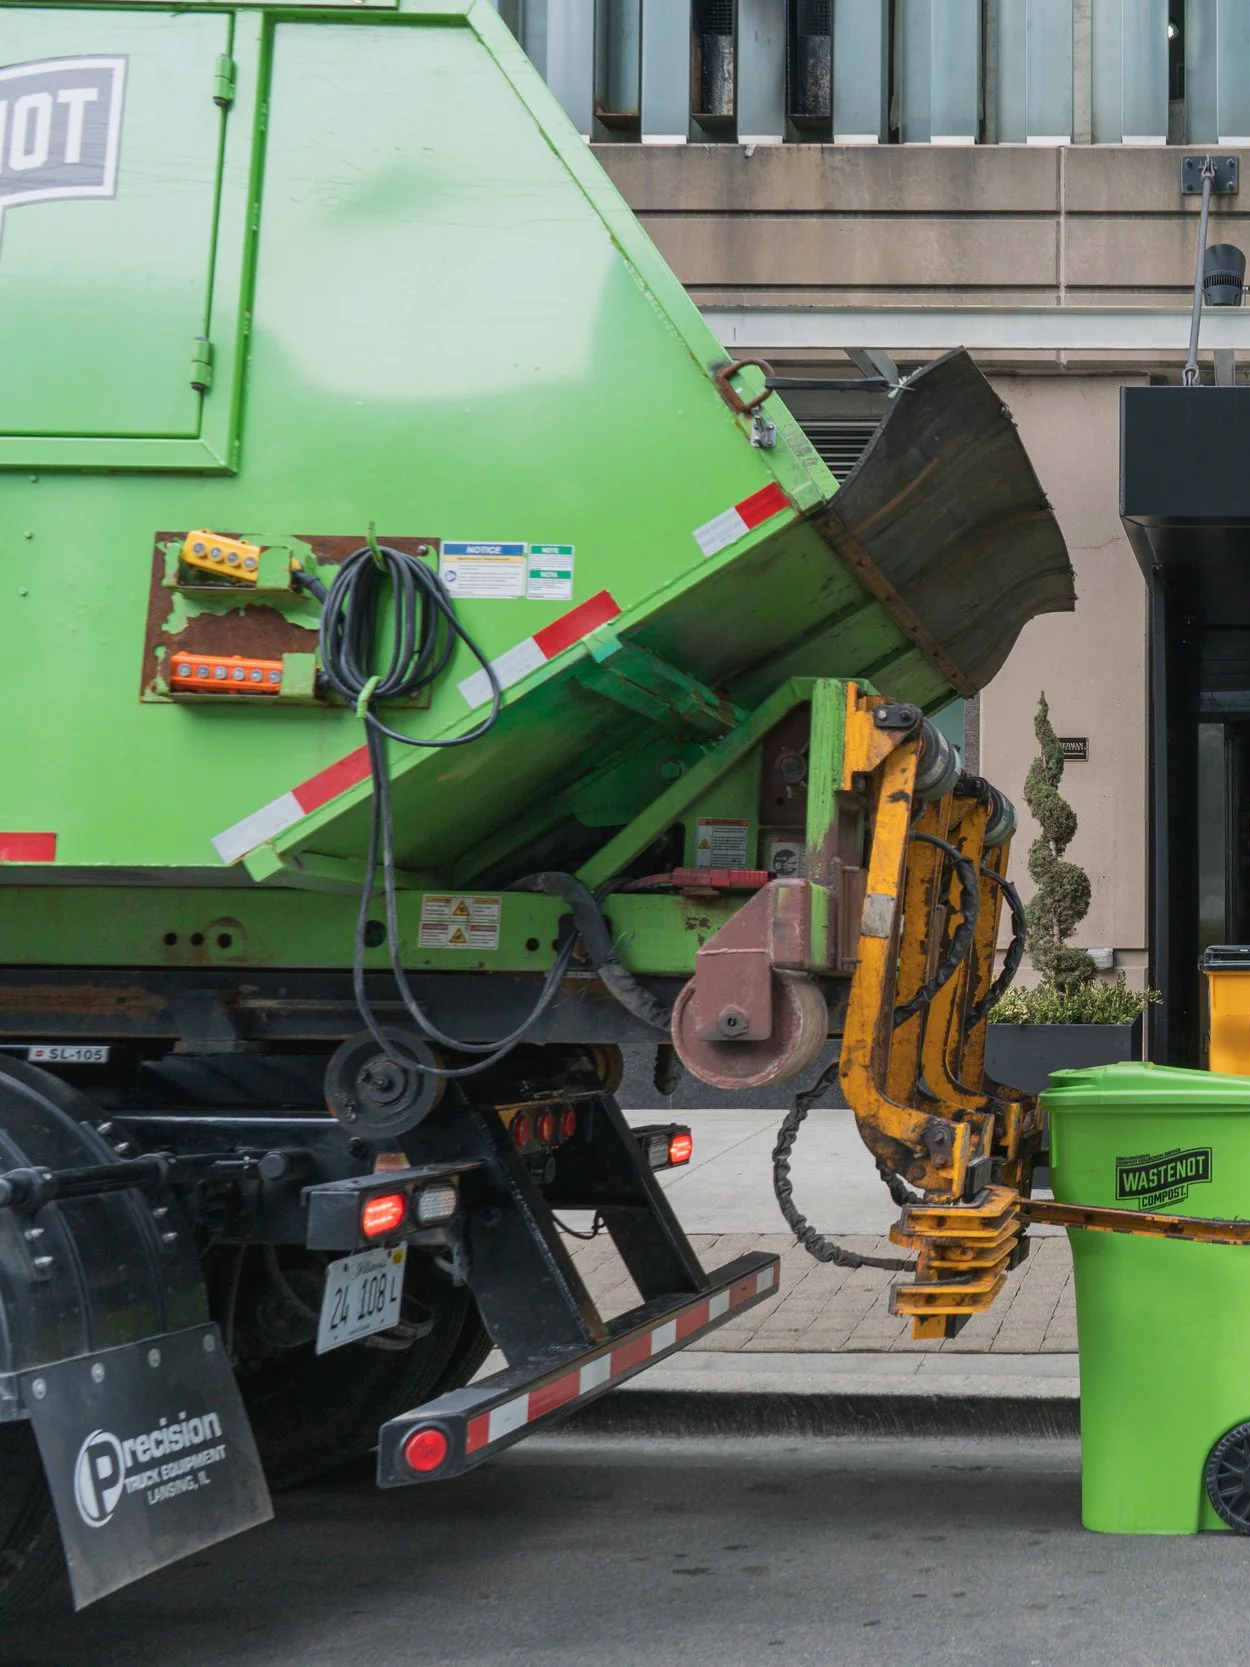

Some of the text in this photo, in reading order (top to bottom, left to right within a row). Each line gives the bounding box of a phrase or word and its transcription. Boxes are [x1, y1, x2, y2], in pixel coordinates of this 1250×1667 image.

[465, 546, 502, 554] NOTICE
[49, 1048, 103, 1060] SL-105
[1123, 1156, 1206, 1192] WASTENOT
[358, 1273, 387, 1321] 108
[390, 1276, 397, 1303] L
[78, 1411, 222, 1525] Precision
[124, 1444, 226, 1494] TRUCK EQUIPMENT
[147, 1470, 212, 1506] LANSING, IL
